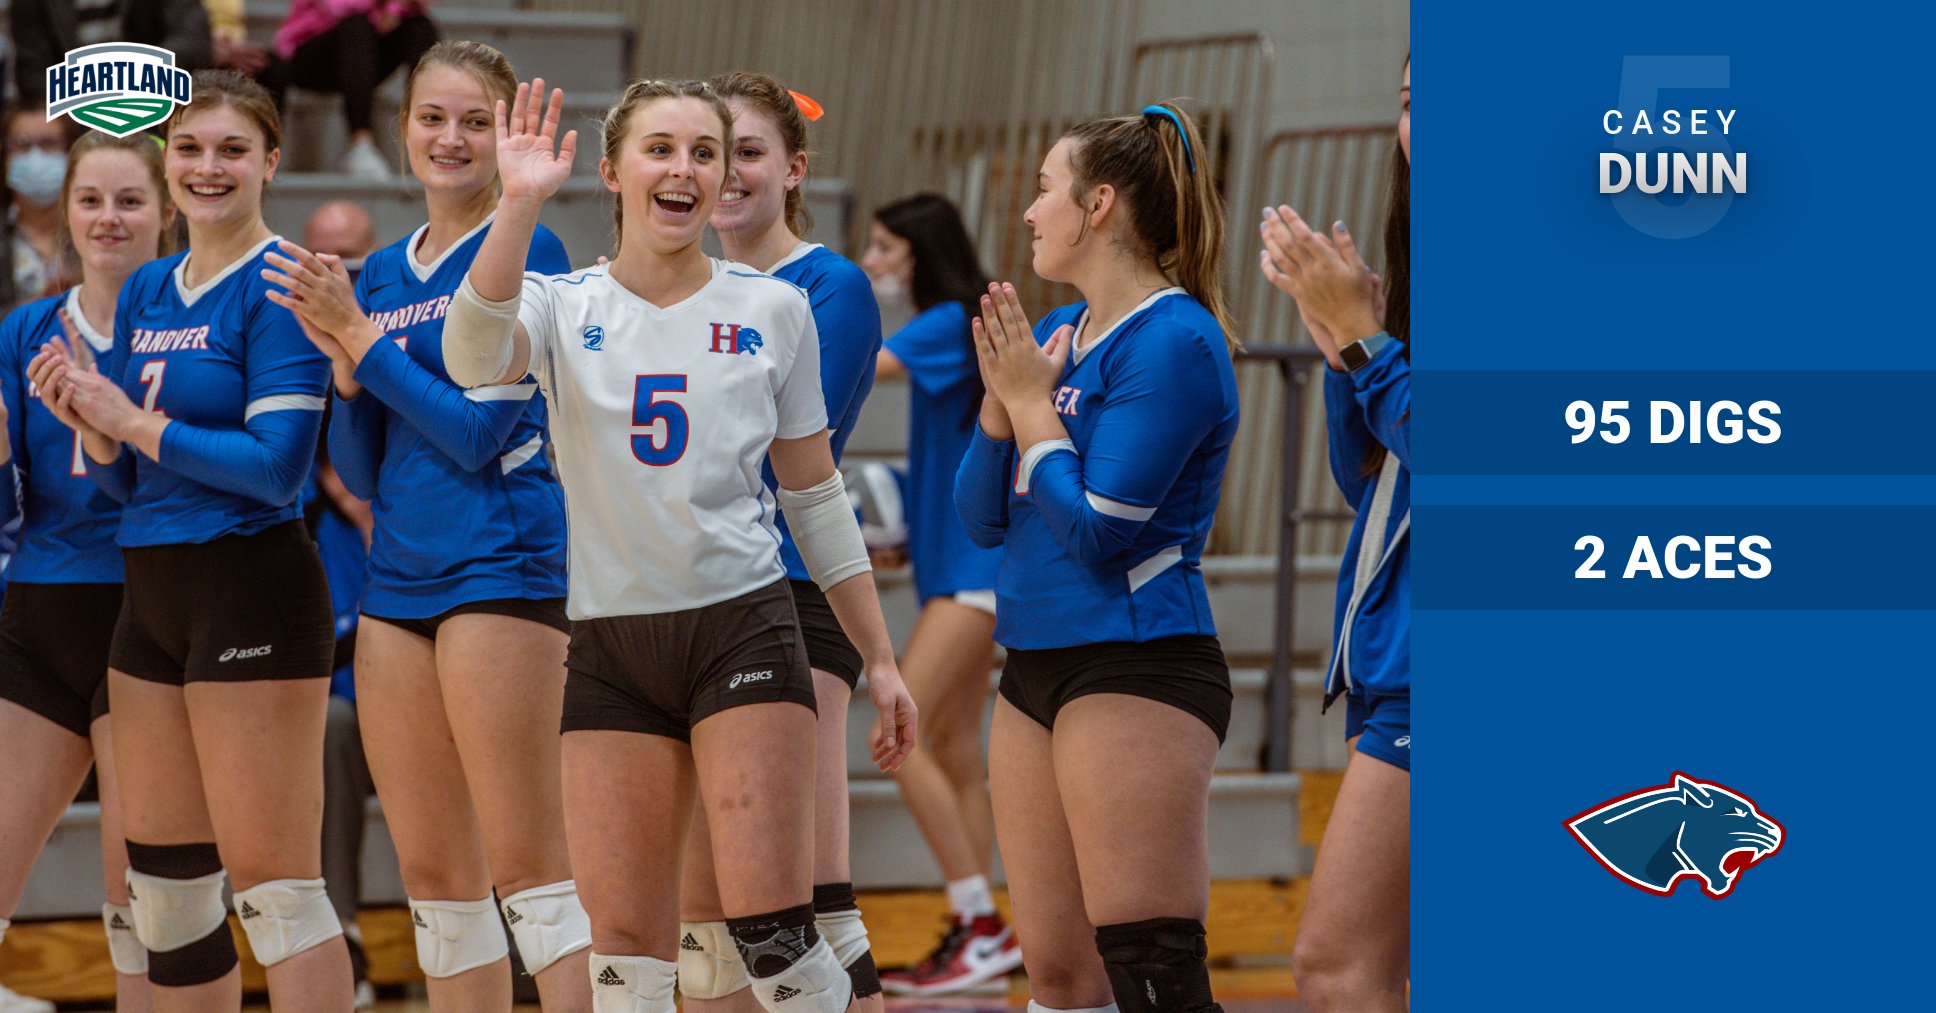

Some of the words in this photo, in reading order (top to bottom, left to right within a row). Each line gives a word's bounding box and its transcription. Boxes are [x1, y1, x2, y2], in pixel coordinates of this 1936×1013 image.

[630, 373, 689, 467] 5
[743, 670, 773, 683] asics
[598, 977, 626, 986] adidas
